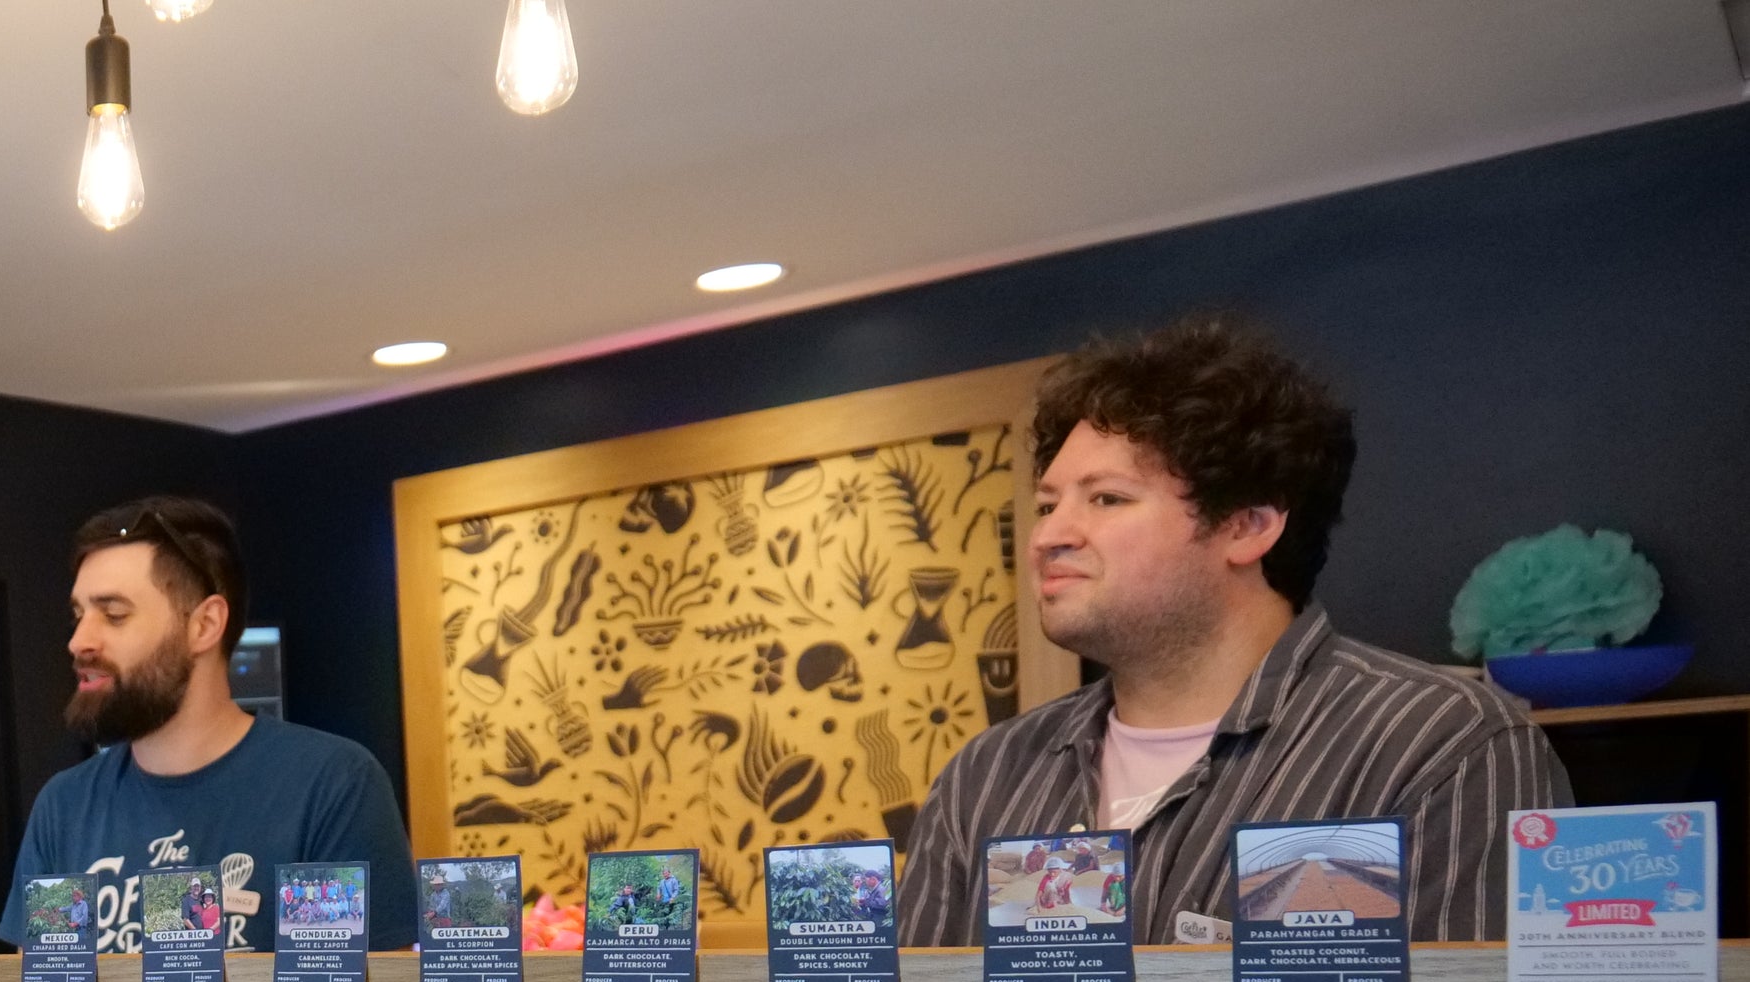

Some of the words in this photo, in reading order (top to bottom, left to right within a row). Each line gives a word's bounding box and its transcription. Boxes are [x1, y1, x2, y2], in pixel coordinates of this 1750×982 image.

[149, 829, 189, 868] The
[1569, 863, 1616, 894] 30
[1578, 904, 1641, 921] LIMITED
[1294, 914, 1342, 925] JAVA
[800, 924, 865, 933] SUMATRA
[1035, 920, 1077, 930] INDIA
[438, 929, 503, 937] GUATEMALA
[624, 927, 653, 935] PERU
[1250, 930, 1335, 938] PARAHYANGAN
[1341, 929, 1379, 937] GRADE
[1519, 933, 1552, 941] 30TH
[1556, 931, 1656, 940] ANNIVERSARY
[1661, 930, 1706, 938] BLEND
[156, 932, 184, 940] COSTA
[999, 935, 1046, 943] MONSOON
[1631, 950, 1676, 958] BODIED
[1533, 962, 1558, 970] AND
[1563, 962, 1605, 970] WORTH
[1609, 961, 1690, 970] CELEBRATING
